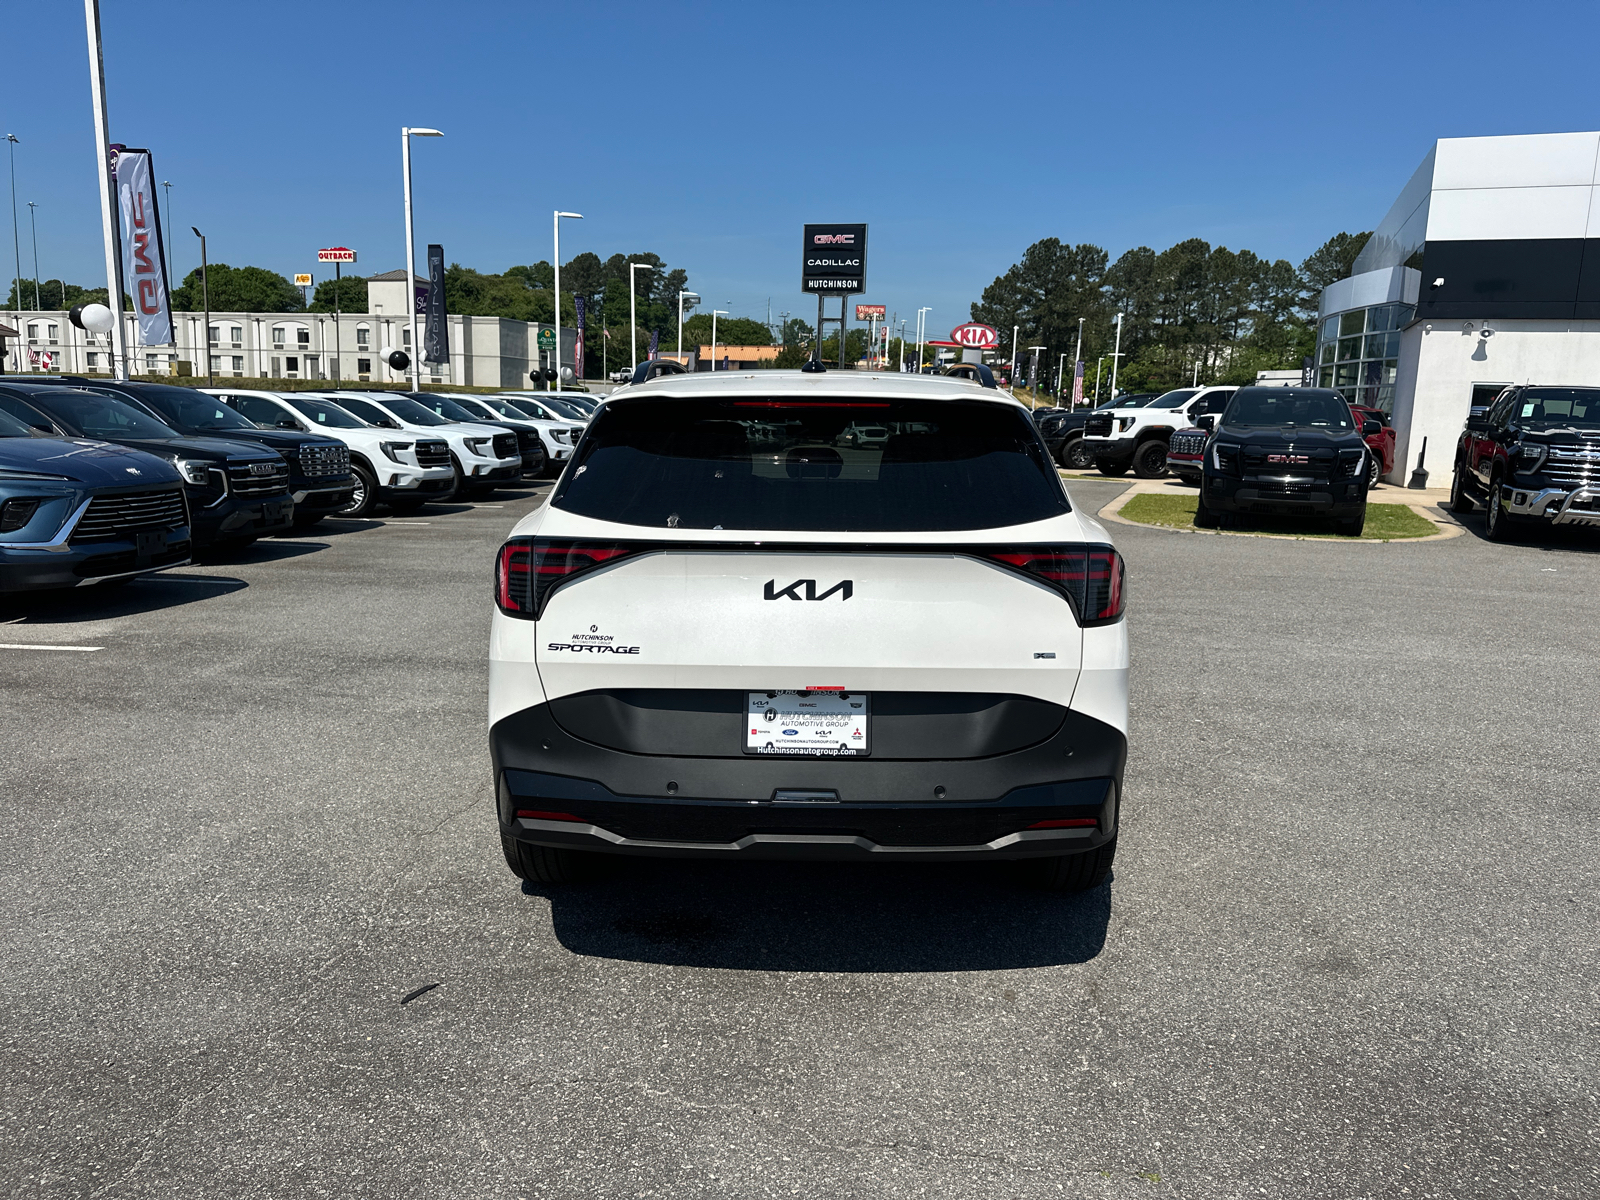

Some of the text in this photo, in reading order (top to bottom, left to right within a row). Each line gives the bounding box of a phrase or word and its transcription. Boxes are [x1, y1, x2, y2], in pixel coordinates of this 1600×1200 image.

[814, 234, 854, 244] GMC
[131, 191, 161, 316] GMC
[318, 252, 353, 260] OUTBACK
[808, 280, 858, 288] HUTCHINSON
[857, 305, 885, 314] Wagers
[960, 328, 989, 343] KIA
[1267, 454, 1309, 464] GMC
[763, 578, 853, 602] KIA
[548, 643, 640, 654] SPORTAGE
[779, 711, 852, 721] HUTCHINSON
[757, 747, 856, 756] Hutchinsonautogroup.com
